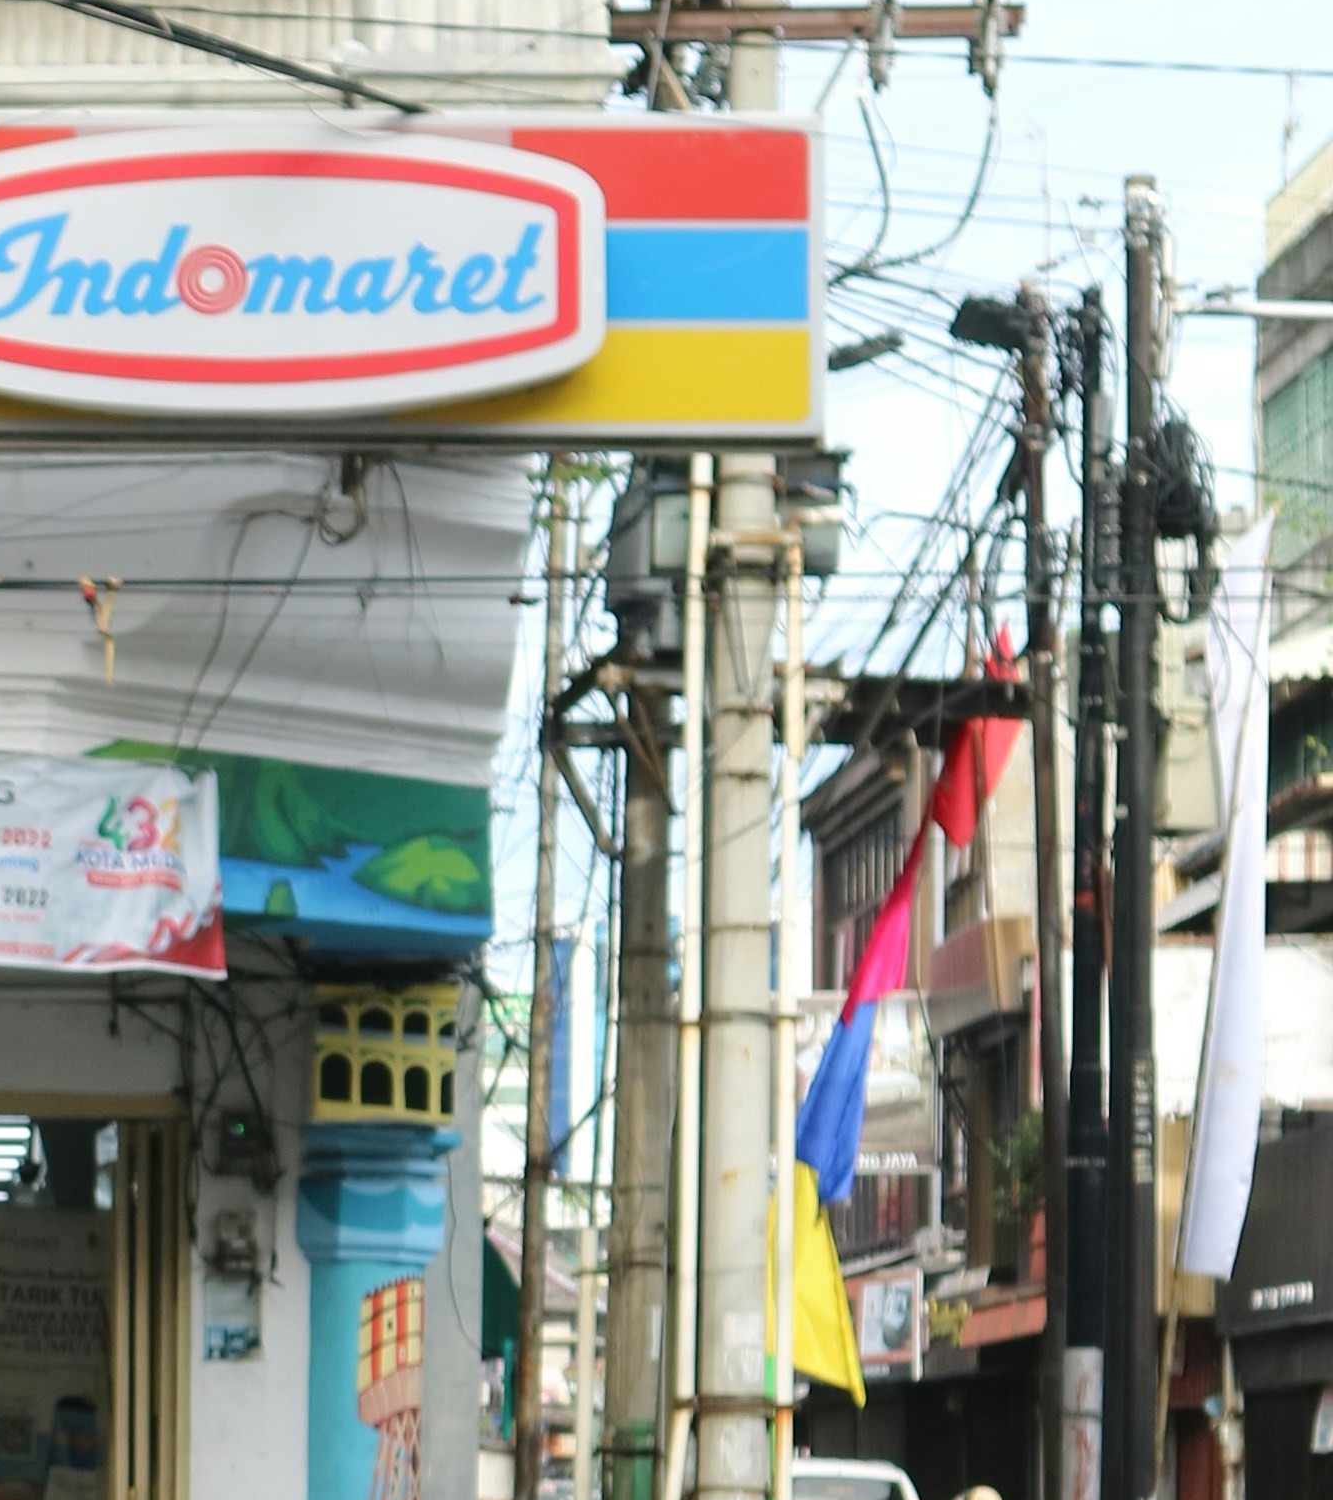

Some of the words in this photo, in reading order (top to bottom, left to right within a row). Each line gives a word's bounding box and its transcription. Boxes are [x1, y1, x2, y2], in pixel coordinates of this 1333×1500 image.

[1, 827, 52, 848] 2022
[884, 1151, 918, 1169] JAYA
[0, 1284, 63, 1306] TARIK
